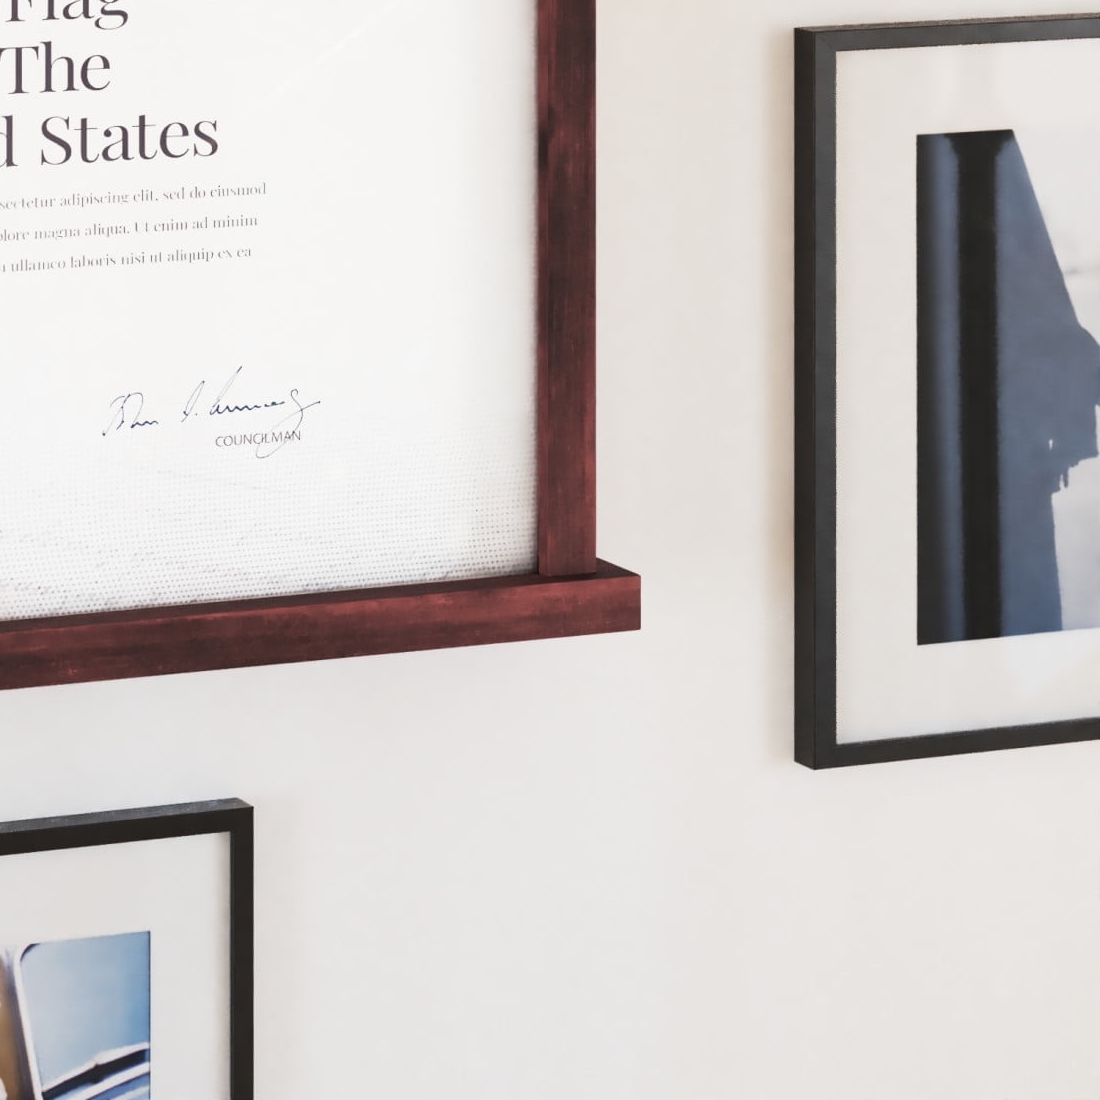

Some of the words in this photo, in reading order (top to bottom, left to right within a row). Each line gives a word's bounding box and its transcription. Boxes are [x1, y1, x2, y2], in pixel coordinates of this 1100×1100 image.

[40, 114, 219, 166] States
[59, 191, 130, 208] adipiscing
[162, 186, 185, 200] sed
[189, 185, 207, 199] do
[209, 181, 266, 198] eiusmod
[34, 228, 81, 241] magna
[153, 218, 188, 232] enim
[191, 215, 208, 230] ad
[213, 214, 258, 229] minim
[10, 258, 66, 273] ullamco
[70, 253, 117, 269] laboris
[121, 251, 145, 266] nisi
[150, 251, 162, 264] ut
[167, 247, 214, 264] aliquip
[217, 249, 233, 259] ex
[236, 247, 252, 258] ea
[214, 430, 302, 448] COUNCILMAN
